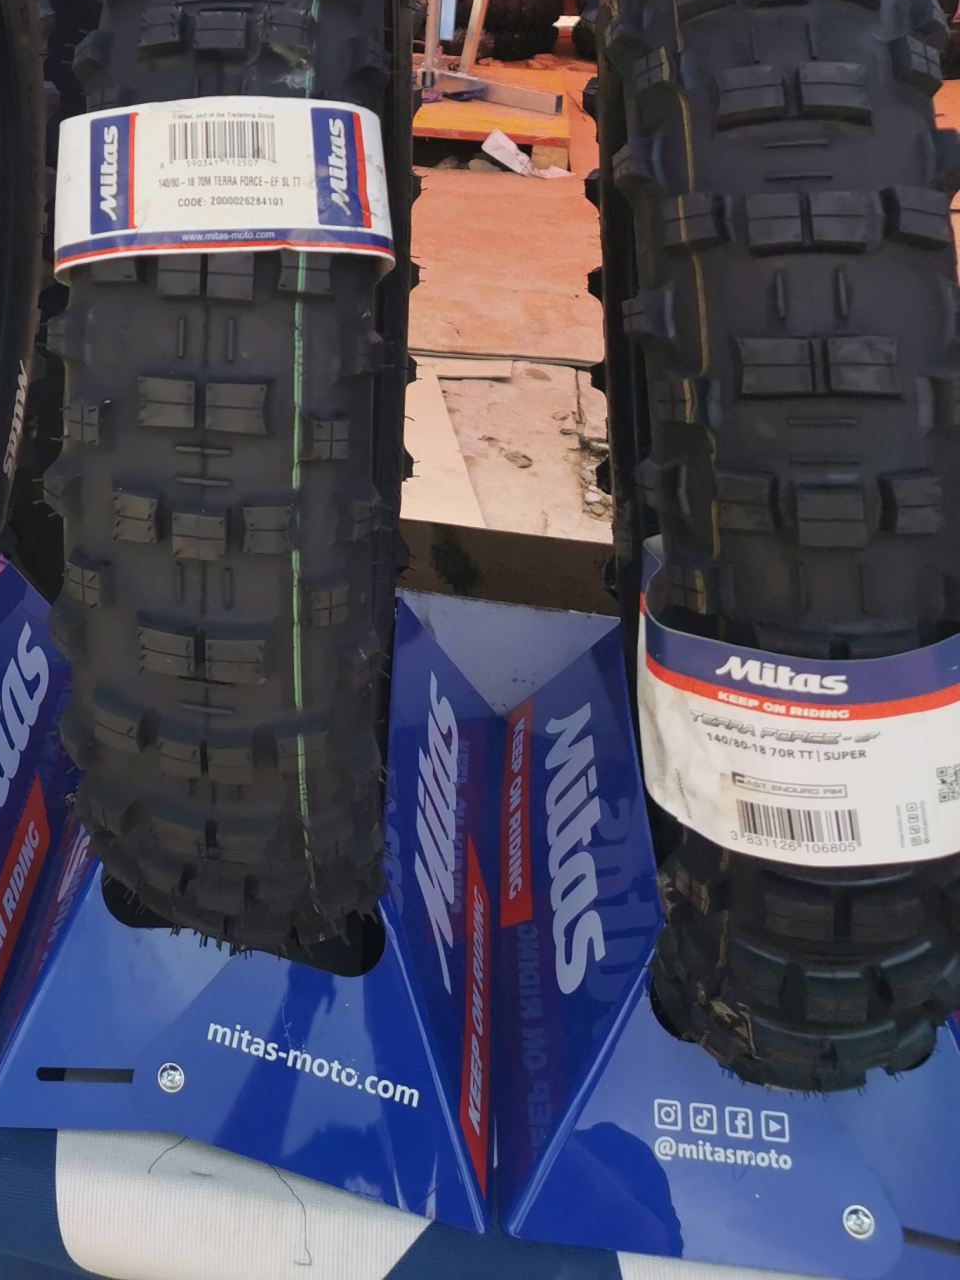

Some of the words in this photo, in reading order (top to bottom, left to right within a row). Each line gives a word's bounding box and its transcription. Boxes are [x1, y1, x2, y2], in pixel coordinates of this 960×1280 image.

[98, 125, 120, 222] Mitas
[214, 176, 237, 187] TERRA
[329, 117, 352, 217] Mitas
[178, 198, 206, 207] CODE:
[181, 230, 275, 241] www.mitas-moto.com
[715, 656, 849, 695] Mitas
[690, 709, 756, 737] TERRA
[717, 691, 759, 707] KEEP
[762, 702, 786, 714] ON
[790, 706, 850, 719] RIDING
[510, 717, 525, 773] KEEP
[706, 732, 767, 755] 140/80-18
[771, 747, 795, 759] 70R
[799, 750, 813, 760] TT
[824, 749, 867, 761] SUPER
[509, 776, 522, 814] ON
[414, 670, 460, 995] Mitas
[508, 814, 523, 901] RIDING
[545, 702, 606, 995] Mitas
[2, 821, 41, 920] RIDING
[472, 885, 485, 991] RIDING
[472, 990, 484, 1036] ON
[206, 1019, 420, 1109] mitas-moto.com
[468, 1033, 483, 1136] KEEP
[654, 1135, 792, 1170] @mitasmoto
